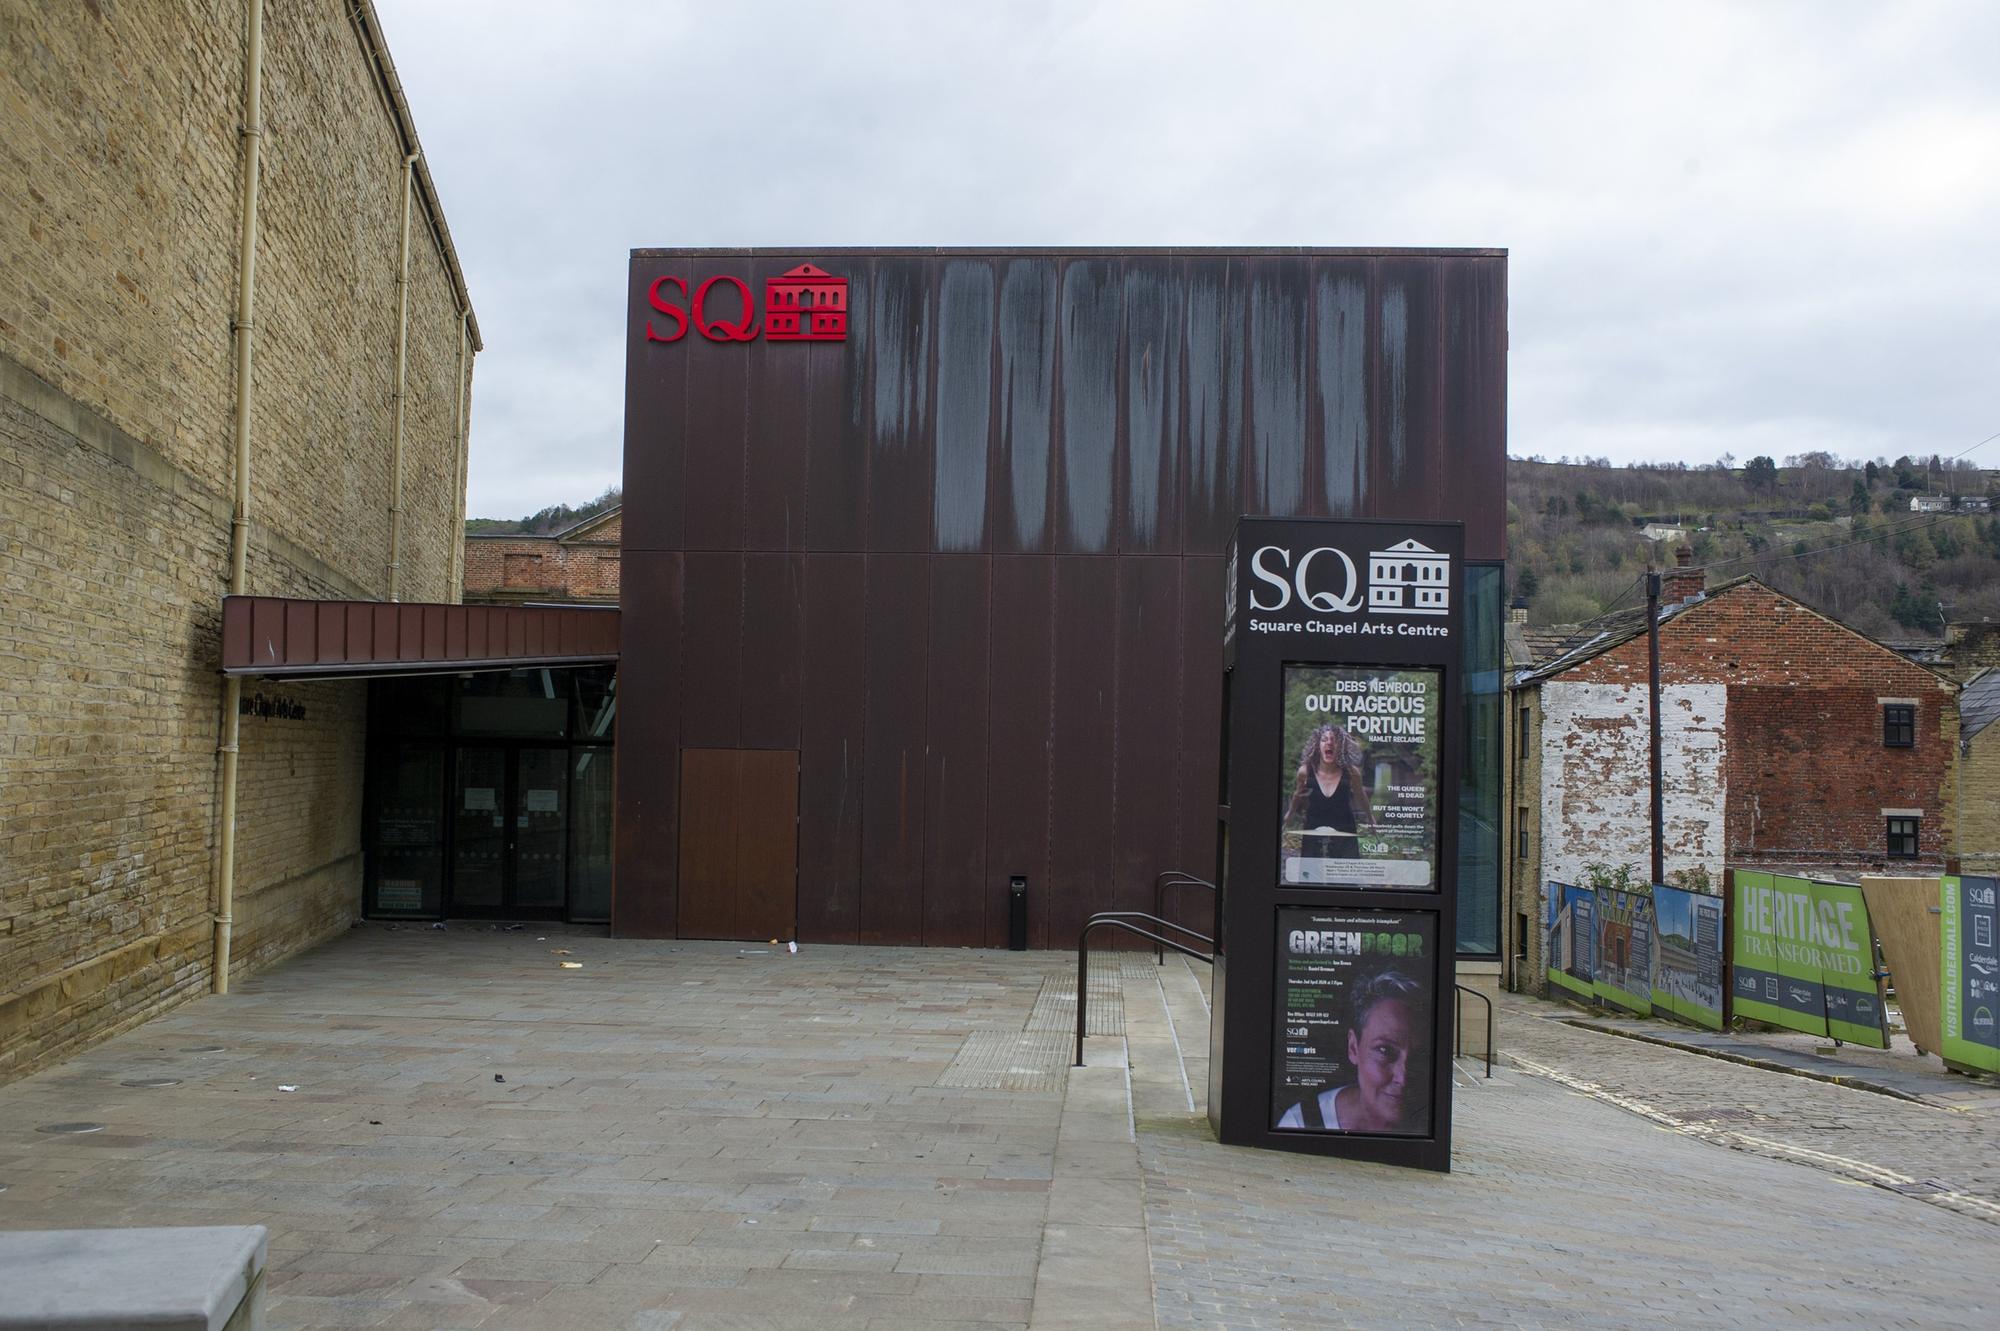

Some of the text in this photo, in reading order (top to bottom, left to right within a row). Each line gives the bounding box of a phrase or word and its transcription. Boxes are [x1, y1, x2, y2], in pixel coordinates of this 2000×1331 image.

[646, 275, 761, 343] SQ
[1249, 545, 1364, 613] SQ
[1249, 618, 1449, 637] Square Chapel Arts Centre
[1335, 680, 1426, 694] DEBS NEWBOLD
[1304, 694, 1426, 715] OUTRAGEOUS
[1347, 715, 1426, 735] FORTUNE
[1368, 735, 1426, 744] HAMLET RECLAIMED
[1969, 887, 1984, 904] SQ
[1743, 886, 1859, 951] HERITAGE
[1743, 935, 1861, 975] TRANSFORMED
[1947, 883, 1956, 1037] VISITCALDERDALE.COM
[1969, 953, 1998, 967] Calderdale
